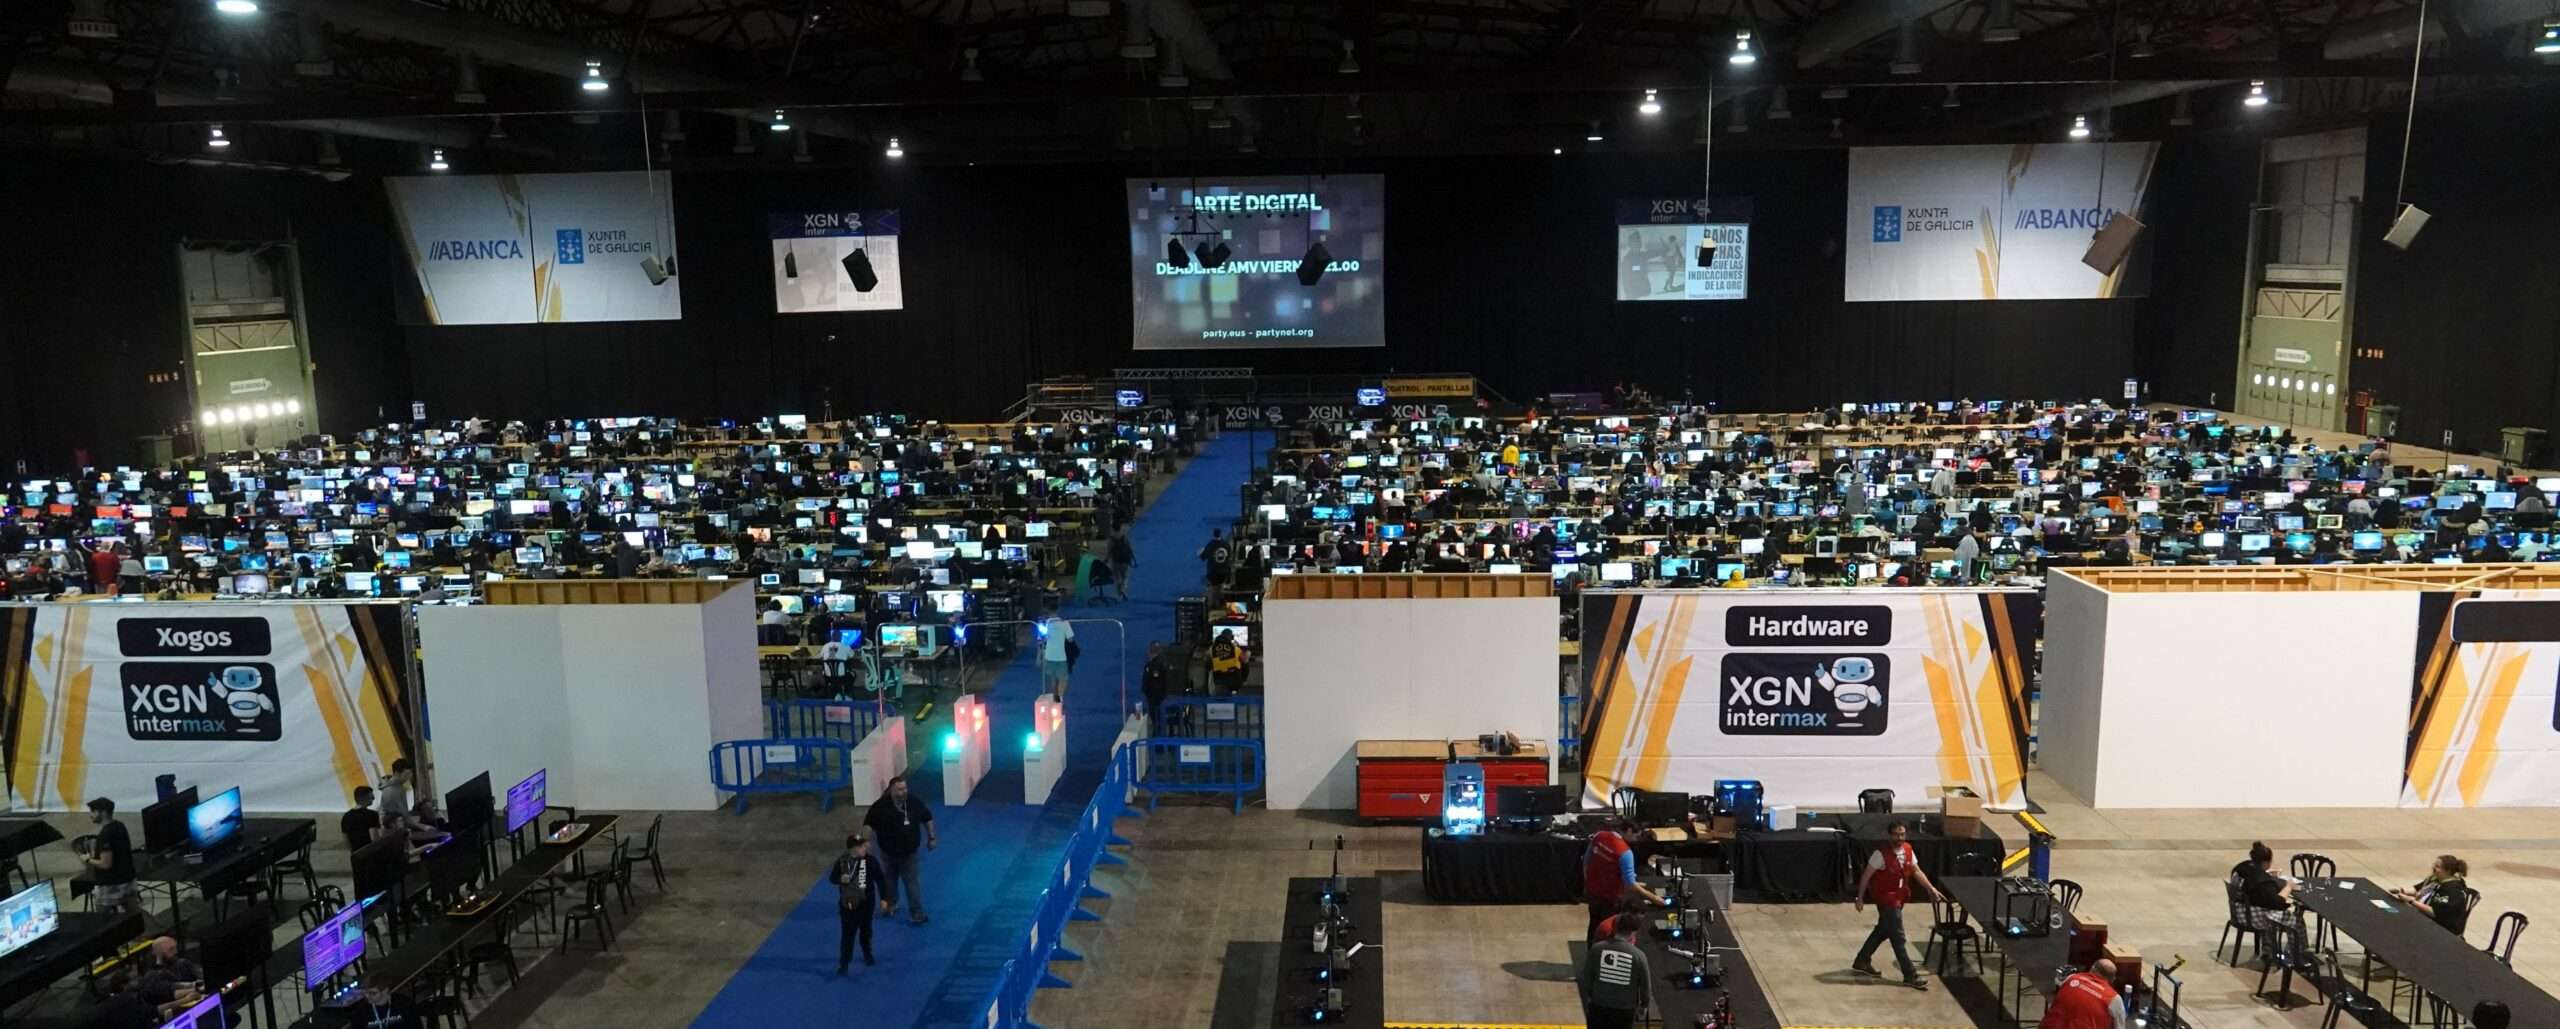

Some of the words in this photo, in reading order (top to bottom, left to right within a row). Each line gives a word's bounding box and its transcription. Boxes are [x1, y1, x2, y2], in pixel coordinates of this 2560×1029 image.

[1194, 195, 1241, 211] ARTE
[1245, 193, 1322, 211] DIGITAL
[1651, 200, 1688, 214] XGN
[804, 213, 839, 227] XGN
[1907, 208, 1949, 218] XUNTA
[1906, 221, 1922, 232] DE
[1923, 220, 1974, 231] GALICIA
[588, 230, 626, 241] XUNTA
[588, 242, 604, 254] DE
[604, 241, 652, 253] GALICIA
[1227, 261, 1260, 274] AMV
[1202, 329, 1247, 339] party.eus
[1255, 327, 1315, 339] partynet.org
[1060, 408, 1095, 423] XGN
[1225, 406, 1261, 421] XGN
[1308, 405, 1343, 420] XGN
[1748, 615, 1869, 637] Hardware
[156, 627, 232, 652] Xogos
[1728, 675, 1812, 706] XGN
[130, 683, 209, 714] XGN
[132, 714, 227, 734] intermax
[1726, 707, 1828, 728] intermax
